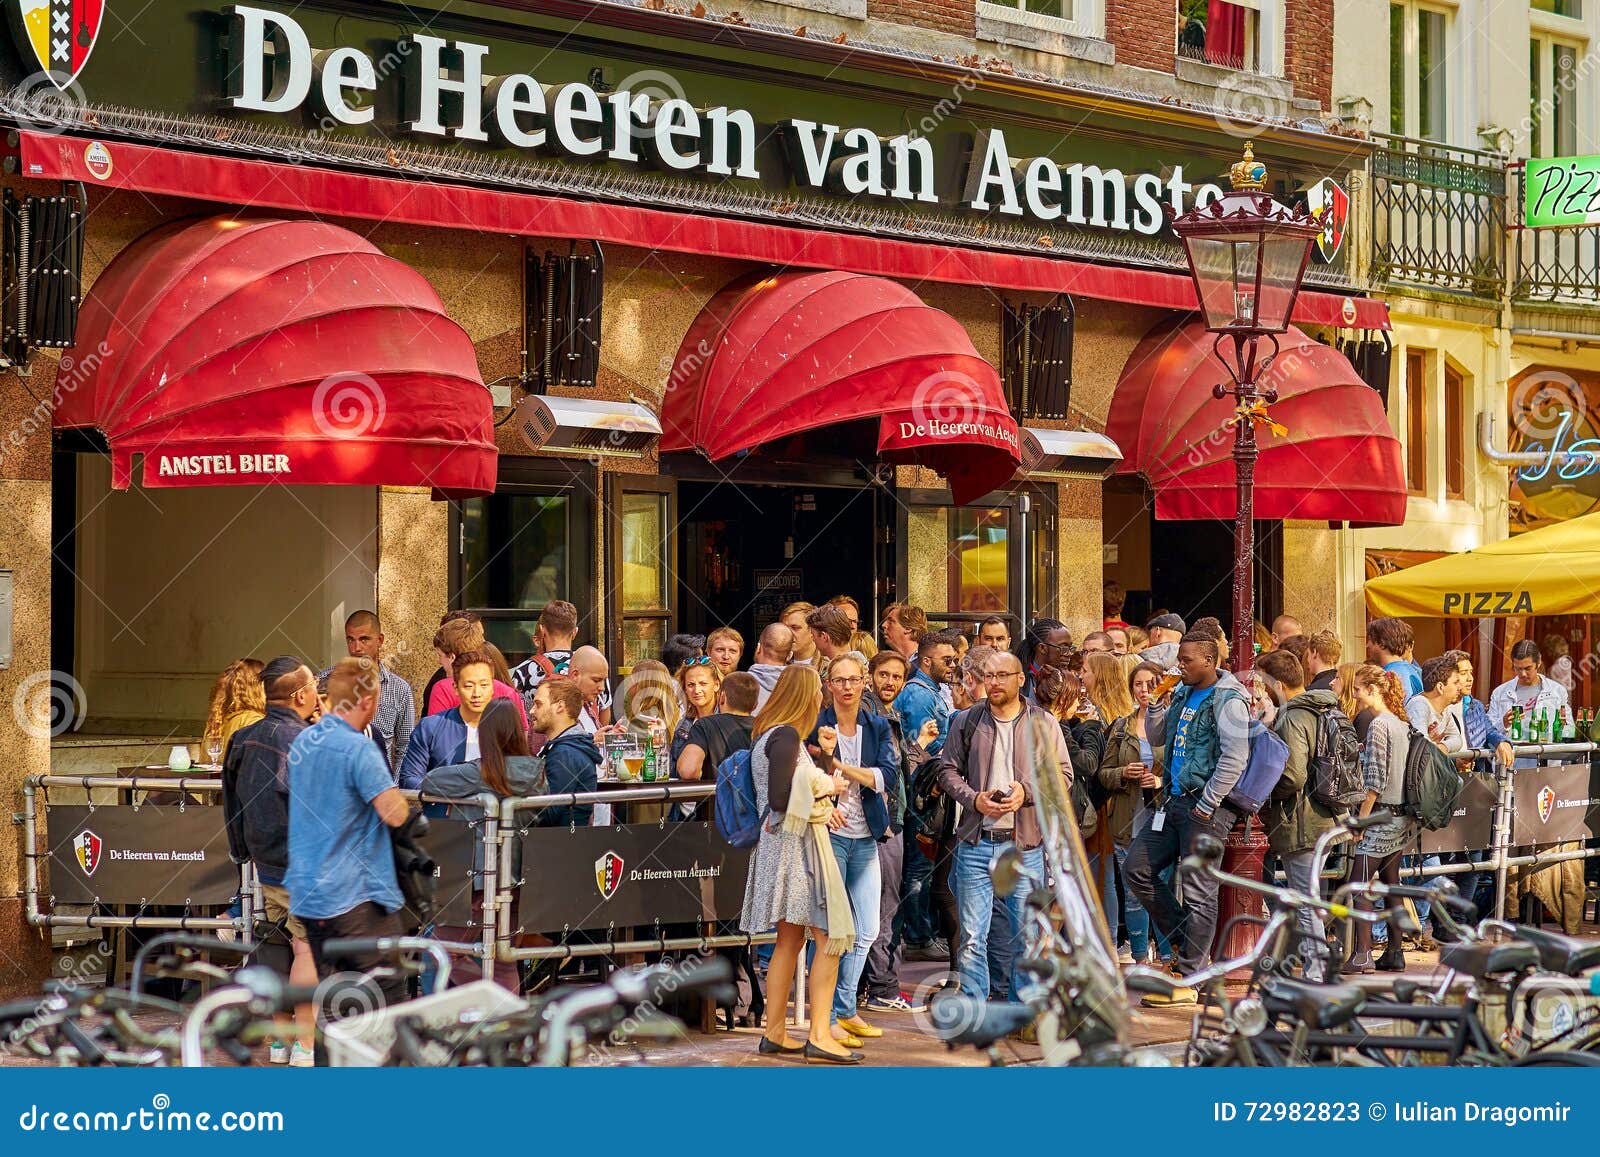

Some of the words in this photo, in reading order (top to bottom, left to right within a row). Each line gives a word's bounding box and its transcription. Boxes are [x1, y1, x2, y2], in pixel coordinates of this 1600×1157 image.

[233, 5, 376, 124] De
[411, 34, 760, 179] Heeren
[792, 119, 938, 203] van
[971, 128, 1225, 239] Aemst
[900, 422, 926, 439] De
[927, 419, 978, 437] Heeren
[979, 423, 995, 438] van
[159, 455, 236, 477] AMSTEL
[239, 453, 292, 474] BIER
[757, 575, 800, 588] UNDERCOVER
[1443, 591, 1533, 614] PIZZA
[109, 849, 122, 860] De
[123, 849, 153, 860] Heeren
[154, 851, 170, 860] van
[171, 850, 205, 861] Aemstel
[630, 869, 642, 881] De
[643, 868, 672, 880] Heeren
[673, 869, 687, 879] van
[688, 865, 721, 878] Aemstel
